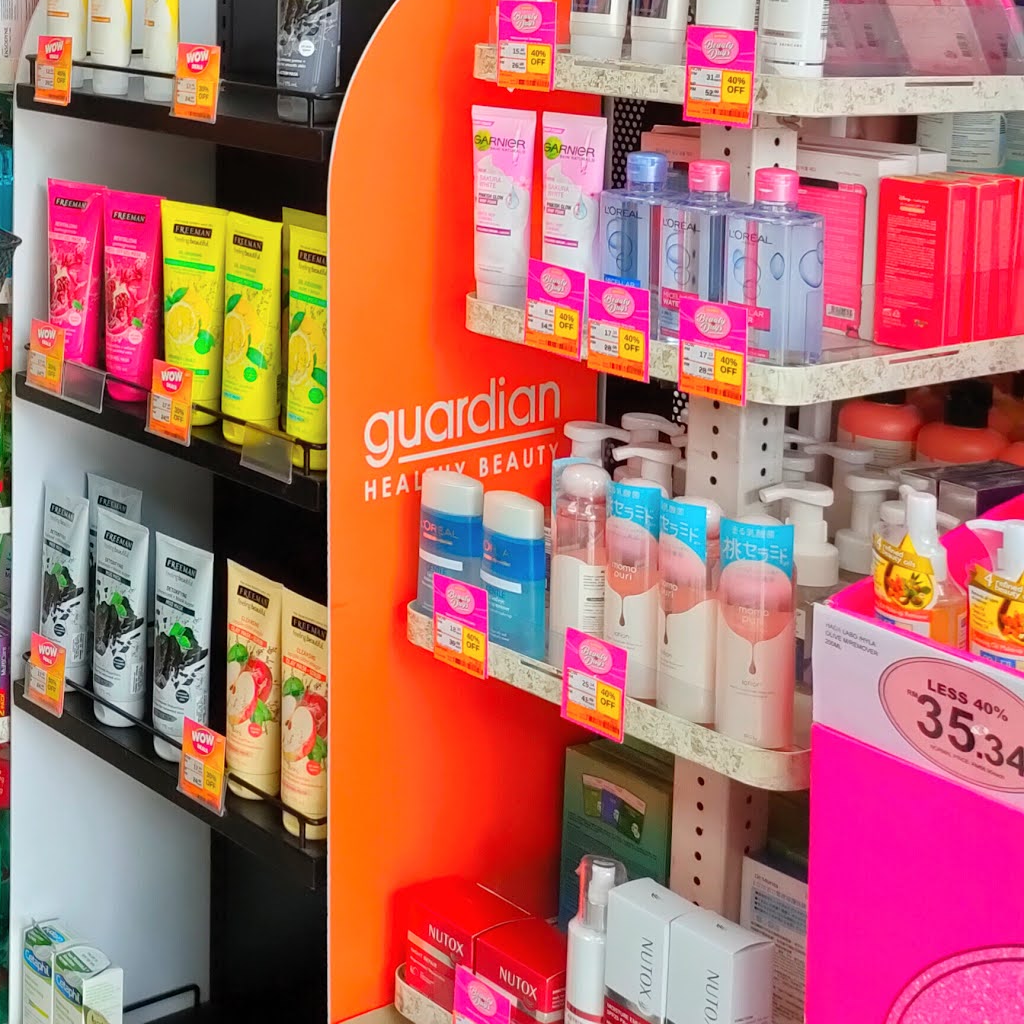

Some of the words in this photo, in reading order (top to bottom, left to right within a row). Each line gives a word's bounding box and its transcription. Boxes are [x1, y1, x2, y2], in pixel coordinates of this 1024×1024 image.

[44, 40, 64, 54] WOW
[704, 40, 734, 50] Beauty
[186, 50, 209, 64] WOW
[531, 49, 546, 58] 40%
[707, 48, 731, 60] Days
[530, 58, 546, 66] OFF
[727, 76, 746, 85] 40%
[727, 86, 745, 94] OFF
[474, 134, 526, 150] GARNIER
[544, 142, 595, 158] GARNIER
[55, 197, 88, 209] FREEMAN
[112, 211, 146, 223] FREEMAN
[174, 225, 212, 237] FREEMAN
[234, 235, 263, 250] FREEMAN
[299, 250, 327, 264] FREEMA
[604, 294, 630, 306] Beauty
[608, 302, 629, 313] Days
[559, 312, 574, 322] 40%
[696, 313, 726, 325] Beauty
[559, 321, 574, 331] OFF
[702, 322, 724, 333] Days
[38, 329, 56, 339] WOW
[623, 333, 640, 344] 40%
[623, 343, 640, 353] OFF
[720, 355, 738, 366] 40%
[161, 370, 183, 382] WOW
[720, 365, 738, 376] OFF
[365, 378, 560, 468] guardian
[364, 461, 466, 502] HEALY
[480, 442, 560, 476] BEAUTY
[99, 496, 127, 513] FREEMAN
[51, 503, 74, 521] FREEMAN
[105, 531, 133, 550] FREEMAN
[723, 538, 788, 562] 桃セラミド
[167, 558, 197, 578] FREEMAN
[612, 561, 637, 574] momo
[984, 573, 993, 587] 4
[239, 586, 268, 607] FREEMAN
[738, 605, 769, 618] momo
[293, 617, 326, 639] FREEMAN
[39, 644, 57, 656] WOW
[600, 688, 616, 700] 40%
[927, 679, 968, 705] LESS
[973, 699, 1008, 722] 40%
[600, 697, 616, 709] OFF
[192, 730, 215, 747] WOW
[917, 694, 1024, 777] 35.34
[429, 924, 464, 957] NUTOX
[24, 950, 50, 977] Cetaphil
[639, 937, 653, 1001] NUTOX
[56, 975, 82, 1005] Cetaphil
[499, 966, 537, 1001] NUTOX
